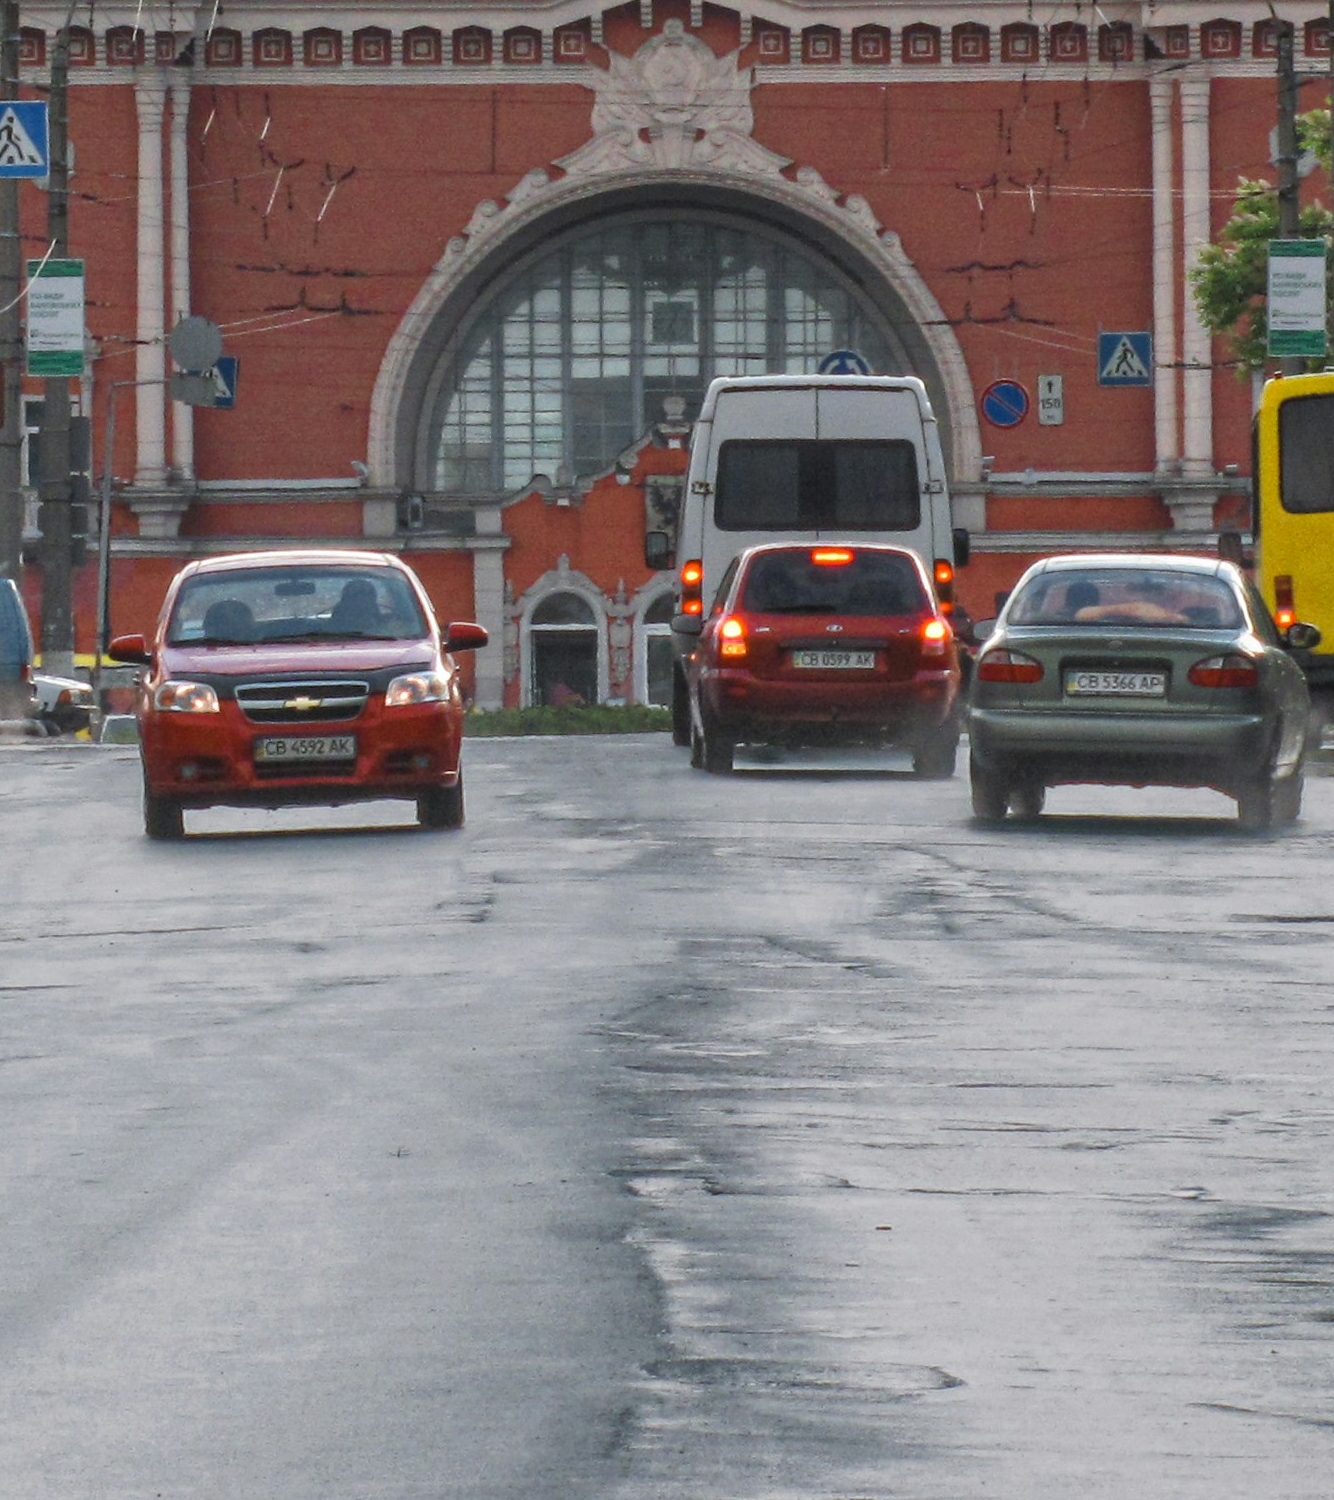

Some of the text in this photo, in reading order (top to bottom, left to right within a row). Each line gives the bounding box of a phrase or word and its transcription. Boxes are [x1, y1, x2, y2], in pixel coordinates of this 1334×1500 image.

[822, 653, 851, 666] 0599
[1077, 675, 1099, 689] CB
[1103, 675, 1136, 690] 5366
[265, 739, 350, 755] CB 4592 AK
